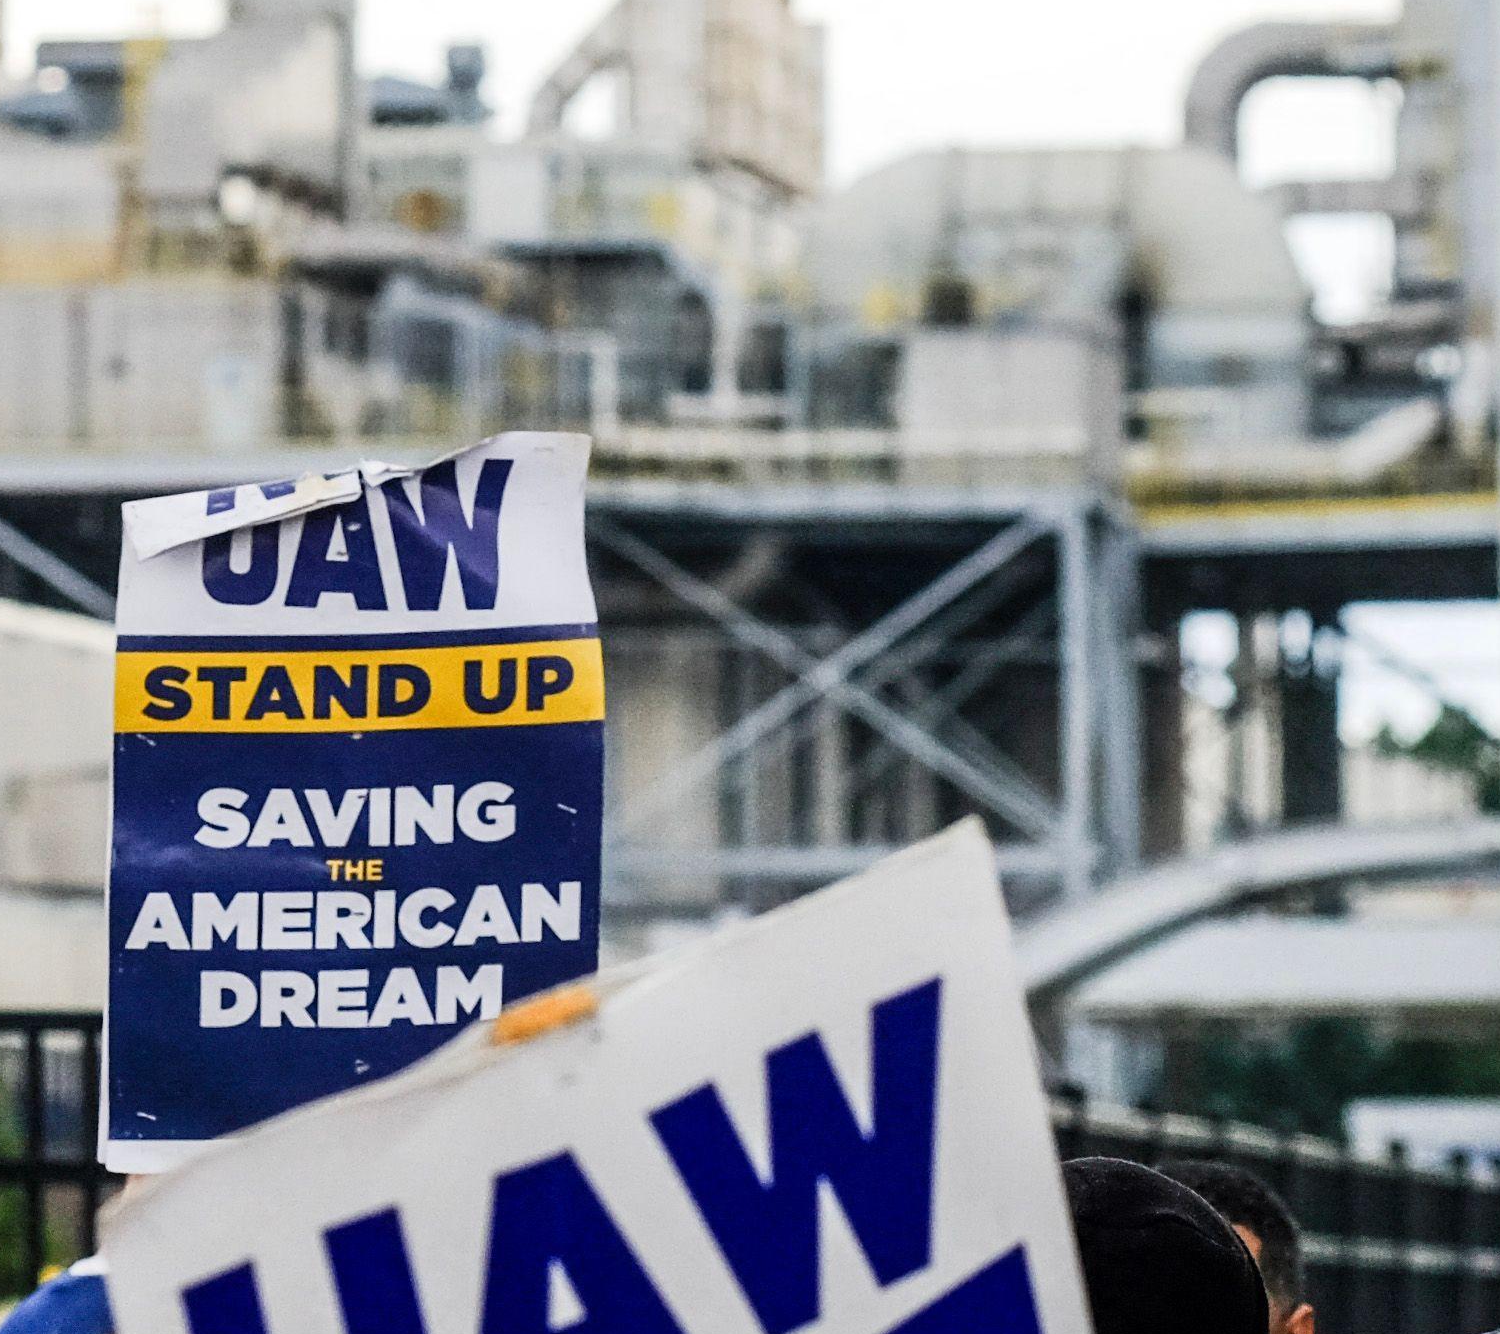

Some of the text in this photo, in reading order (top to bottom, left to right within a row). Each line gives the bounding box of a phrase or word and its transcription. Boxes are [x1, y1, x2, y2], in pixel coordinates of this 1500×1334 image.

[142, 656, 575, 721] STAND UP
[194, 781, 517, 849] SAVING
[327, 858, 383, 883] THE
[125, 881, 581, 951] AMERICAN
[200, 963, 503, 1028] DREAM
